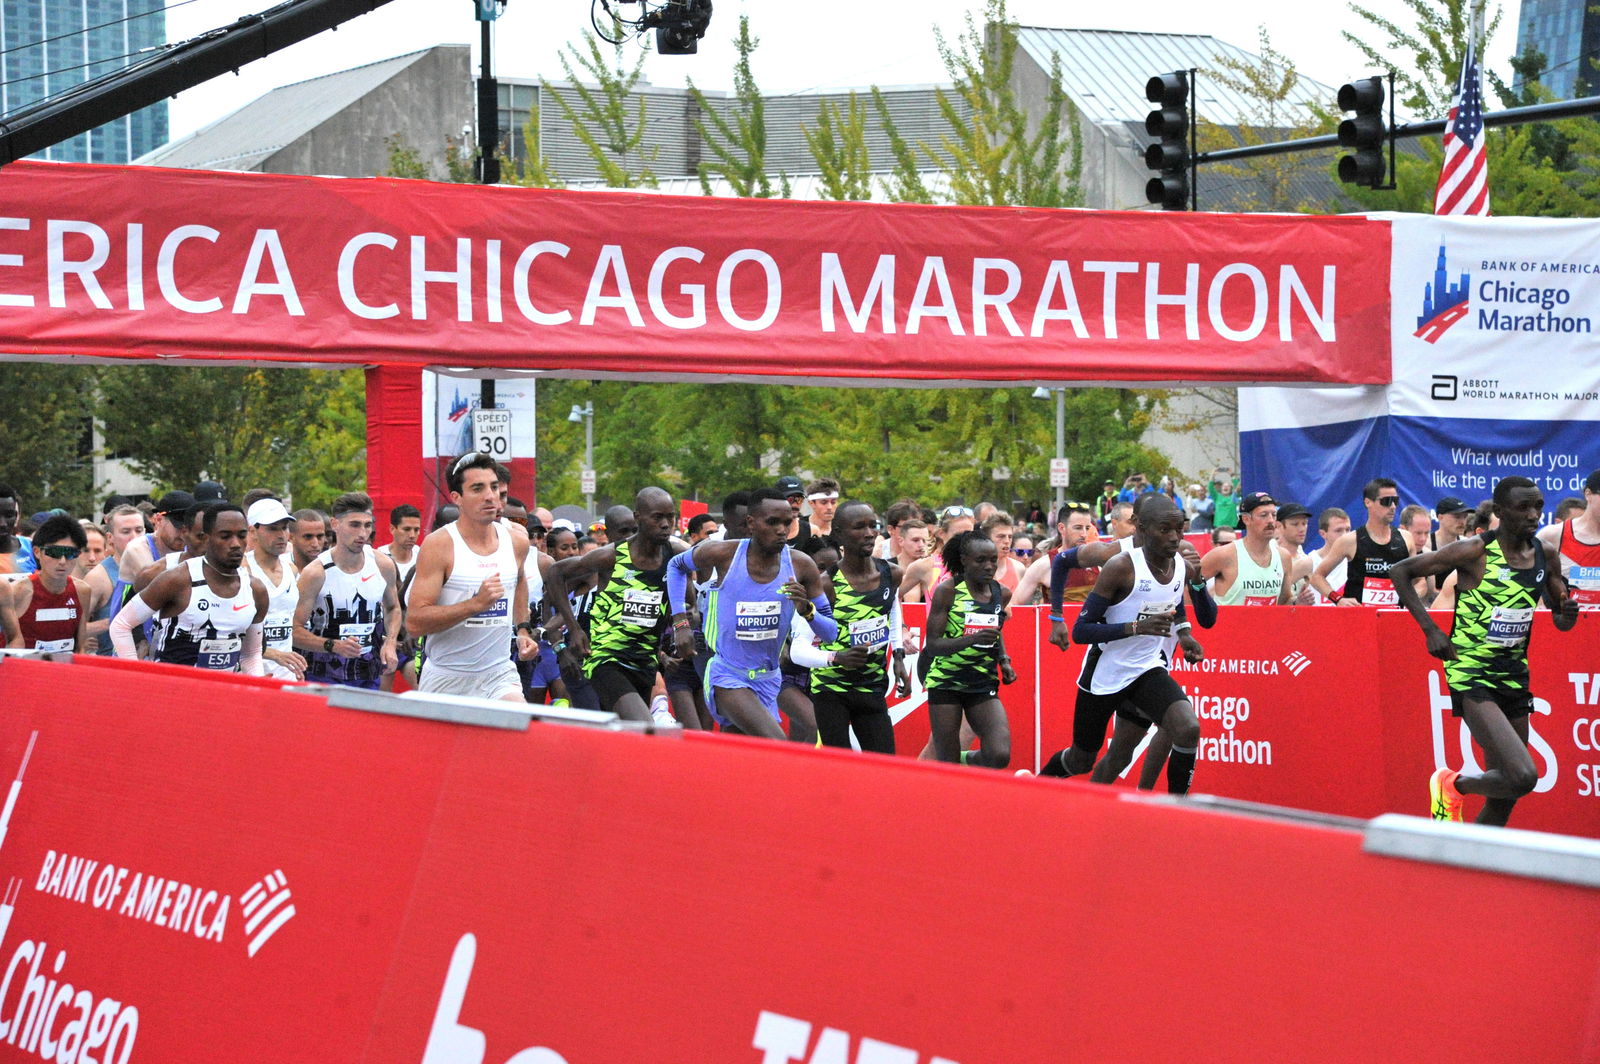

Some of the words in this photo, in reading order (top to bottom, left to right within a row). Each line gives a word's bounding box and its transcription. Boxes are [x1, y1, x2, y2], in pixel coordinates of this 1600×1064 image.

[1481, 260, 1517, 272] BANK
[1520, 262, 1537, 272] OF
[1540, 262, 1600, 274] AMERICA
[337, 232, 782, 332] CHICAGO
[820, 252, 1337, 343] MARATHON
[1479, 279, 1571, 311] Chicago
[1478, 308, 1591, 333] Marathon
[1463, 379, 1499, 388] ABBOTT
[1462, 390, 1496, 399] WORLD
[1499, 391, 1559, 400] MARATHON
[1564, 392, 1599, 401] MAJOR
[476, 414, 508, 423] SPEED
[480, 425, 504, 433] LIMIT
[480, 436, 507, 455] 30
[1451, 448, 1491, 466] What
[1496, 449, 1543, 467] would
[1547, 453, 1578, 472] you
[1432, 469, 1457, 489] like
[1461, 471, 1487, 490] the
[1545, 475, 1563, 491] to
[1370, 591, 1394, 602] 724
[623, 602, 652, 615] PACE
[738, 616, 778, 626] KIPRUTO
[1490, 622, 1530, 633] NGETICH
[854, 628, 885, 645] KORIR
[208, 653, 231, 665] ESA
[1201, 658, 1217, 673] OF
[1219, 659, 1279, 675] AMERICA
[1196, 730, 1272, 765] rathon
[35, 850, 98, 904] BANK
[92, 864, 129, 911] OF
[119, 872, 231, 942] AMERICA
